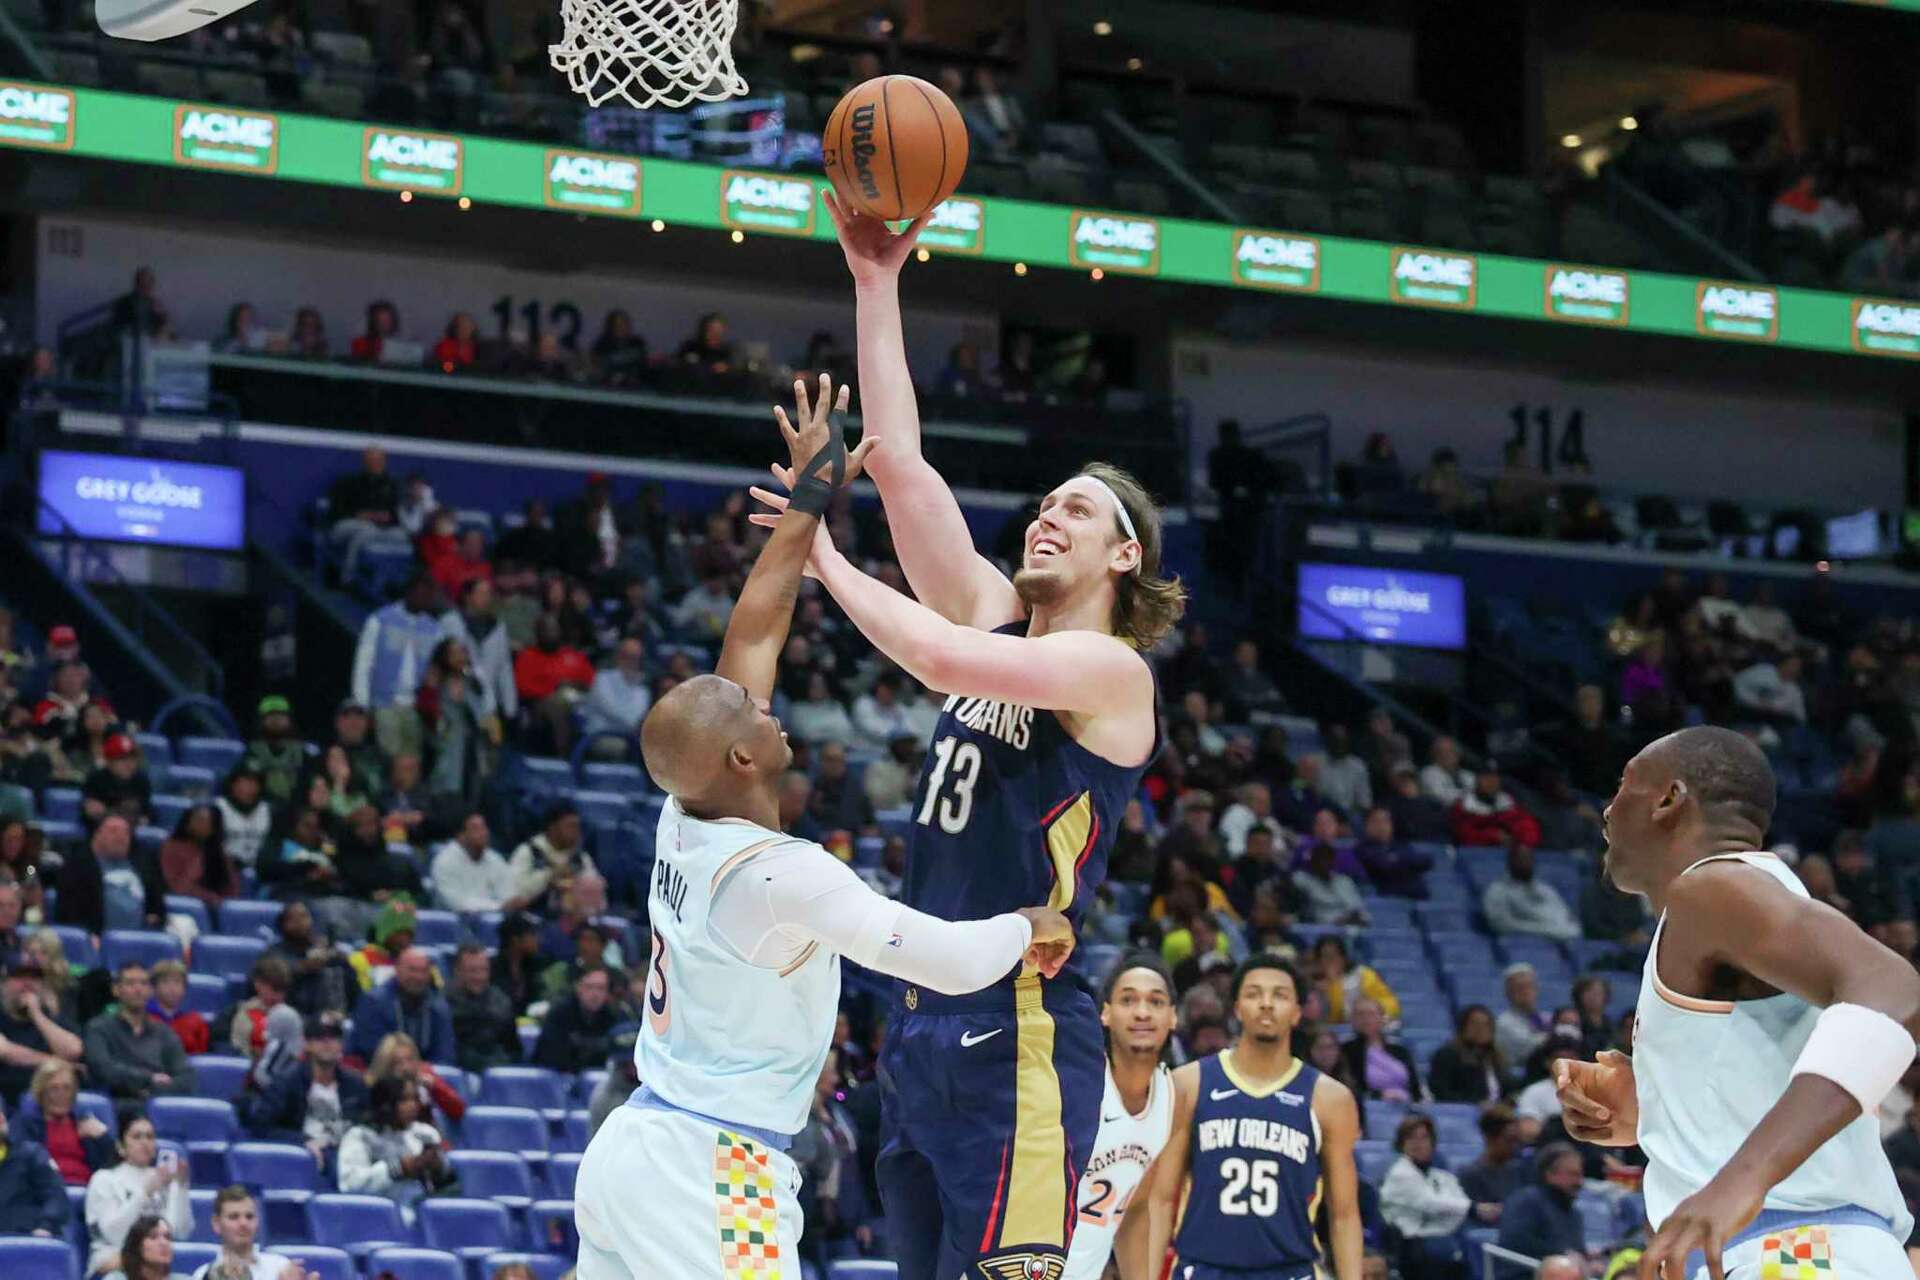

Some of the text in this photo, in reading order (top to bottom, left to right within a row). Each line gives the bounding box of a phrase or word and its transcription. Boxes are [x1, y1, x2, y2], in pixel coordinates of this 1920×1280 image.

[0, 87, 70, 124] CME
[180, 111, 273, 147] ACME
[368, 133, 458, 169] ACME
[851, 103, 880, 199] Wilson
[550, 155, 638, 191] ACME
[725, 175, 811, 211] ACME
[1075, 217, 1156, 251] ACME
[1237, 235, 1316, 268] ACME
[1395, 253, 1472, 286] ACME
[1550, 271, 1626, 303] ACME
[1701, 287, 1775, 320] ACME
[490, 296, 581, 349] 112
[1505, 403, 1591, 475] 114
[75, 475, 203, 509] GREY GOOSE
[1326, 584, 1431, 613] GREY GOOSE
[916, 735, 982, 834] 13
[657, 859, 688, 925] PAUL
[1199, 1117, 1310, 1165] NEW ORLEANS
[1218, 1156, 1280, 1217] 25
